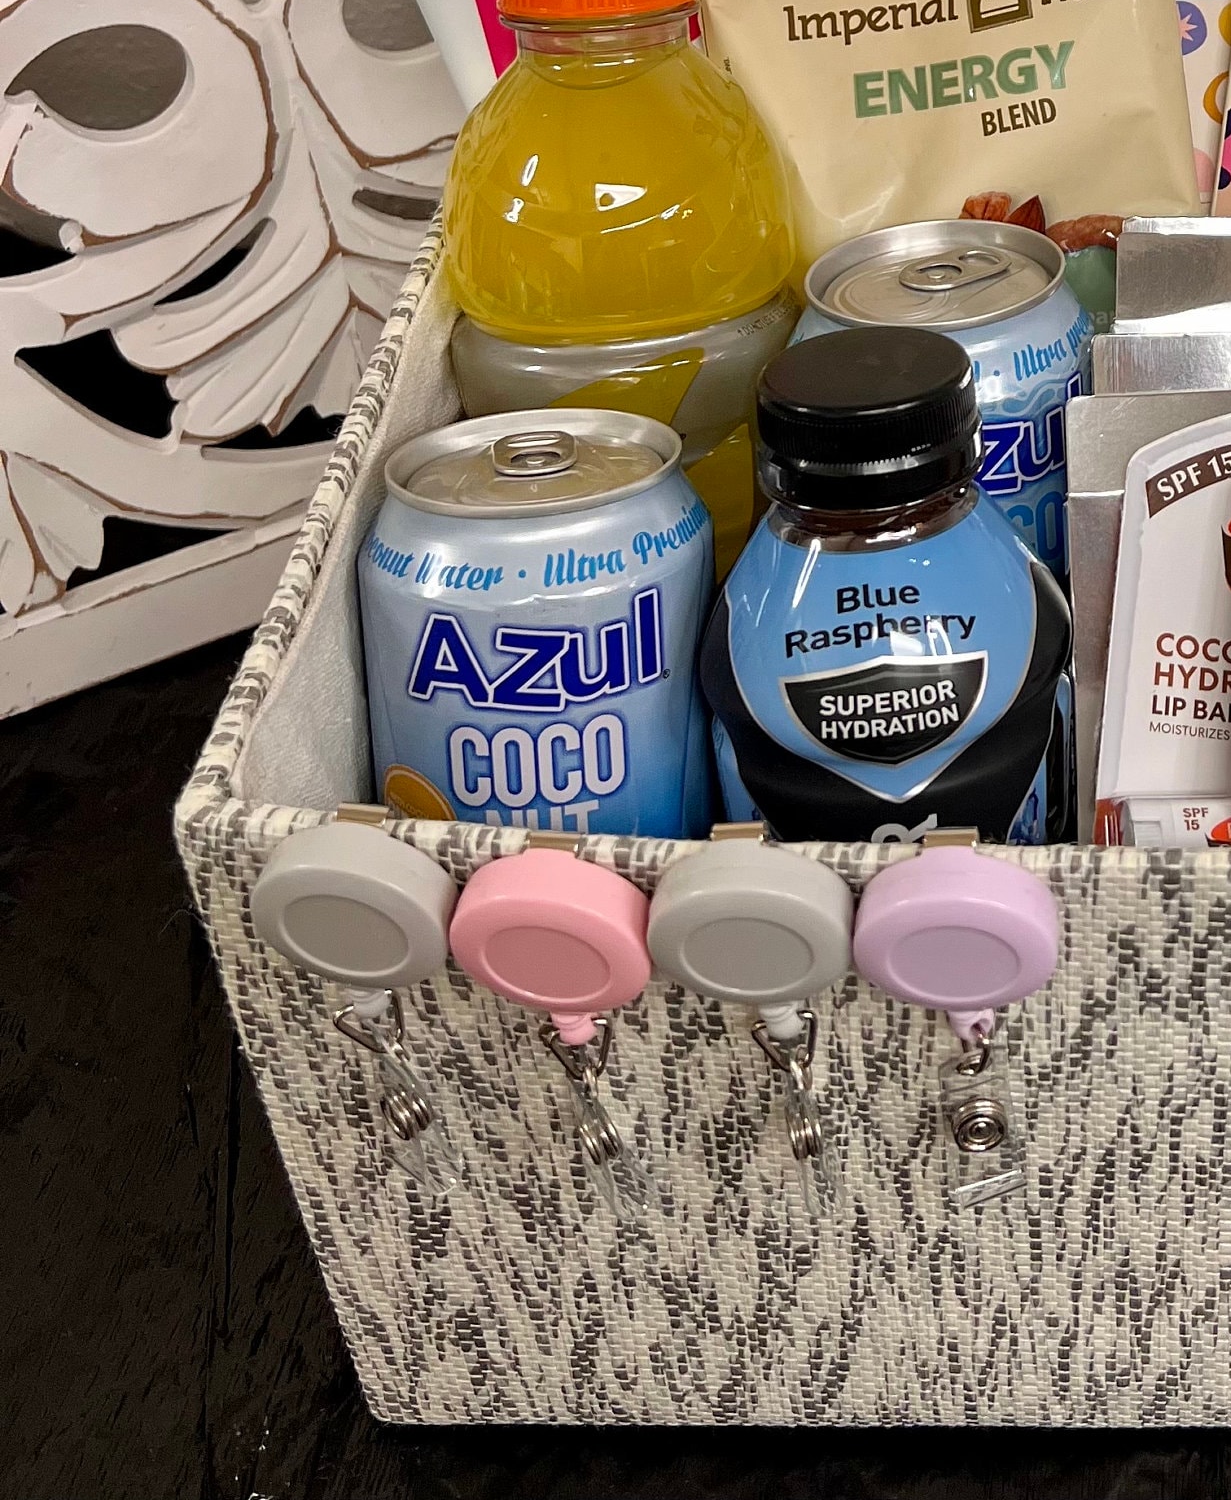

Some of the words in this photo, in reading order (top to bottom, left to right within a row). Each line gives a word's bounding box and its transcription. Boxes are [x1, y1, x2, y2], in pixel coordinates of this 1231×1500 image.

[853, 40, 1075, 118] ENERGY
[981, 97, 1057, 137] BLEND
[1012, 339, 1066, 381] Ultra
[1156, 462, 1202, 501] SPF
[543, 548, 627, 587] Ultra
[835, 583, 921, 614] Blue
[408, 588, 662, 712] Azul
[784, 612, 976, 658] Raspberry
[819, 679, 956, 717] SUPERIOR
[1151, 694, 1187, 717] LIP
[820, 703, 959, 740] HYDRATION
[1148, 721, 1228, 741] MOISTURIZES
[449, 713, 626, 808] COCO
[1182, 807, 1209, 819] SPF
[1184, 819, 1200, 832] 15
